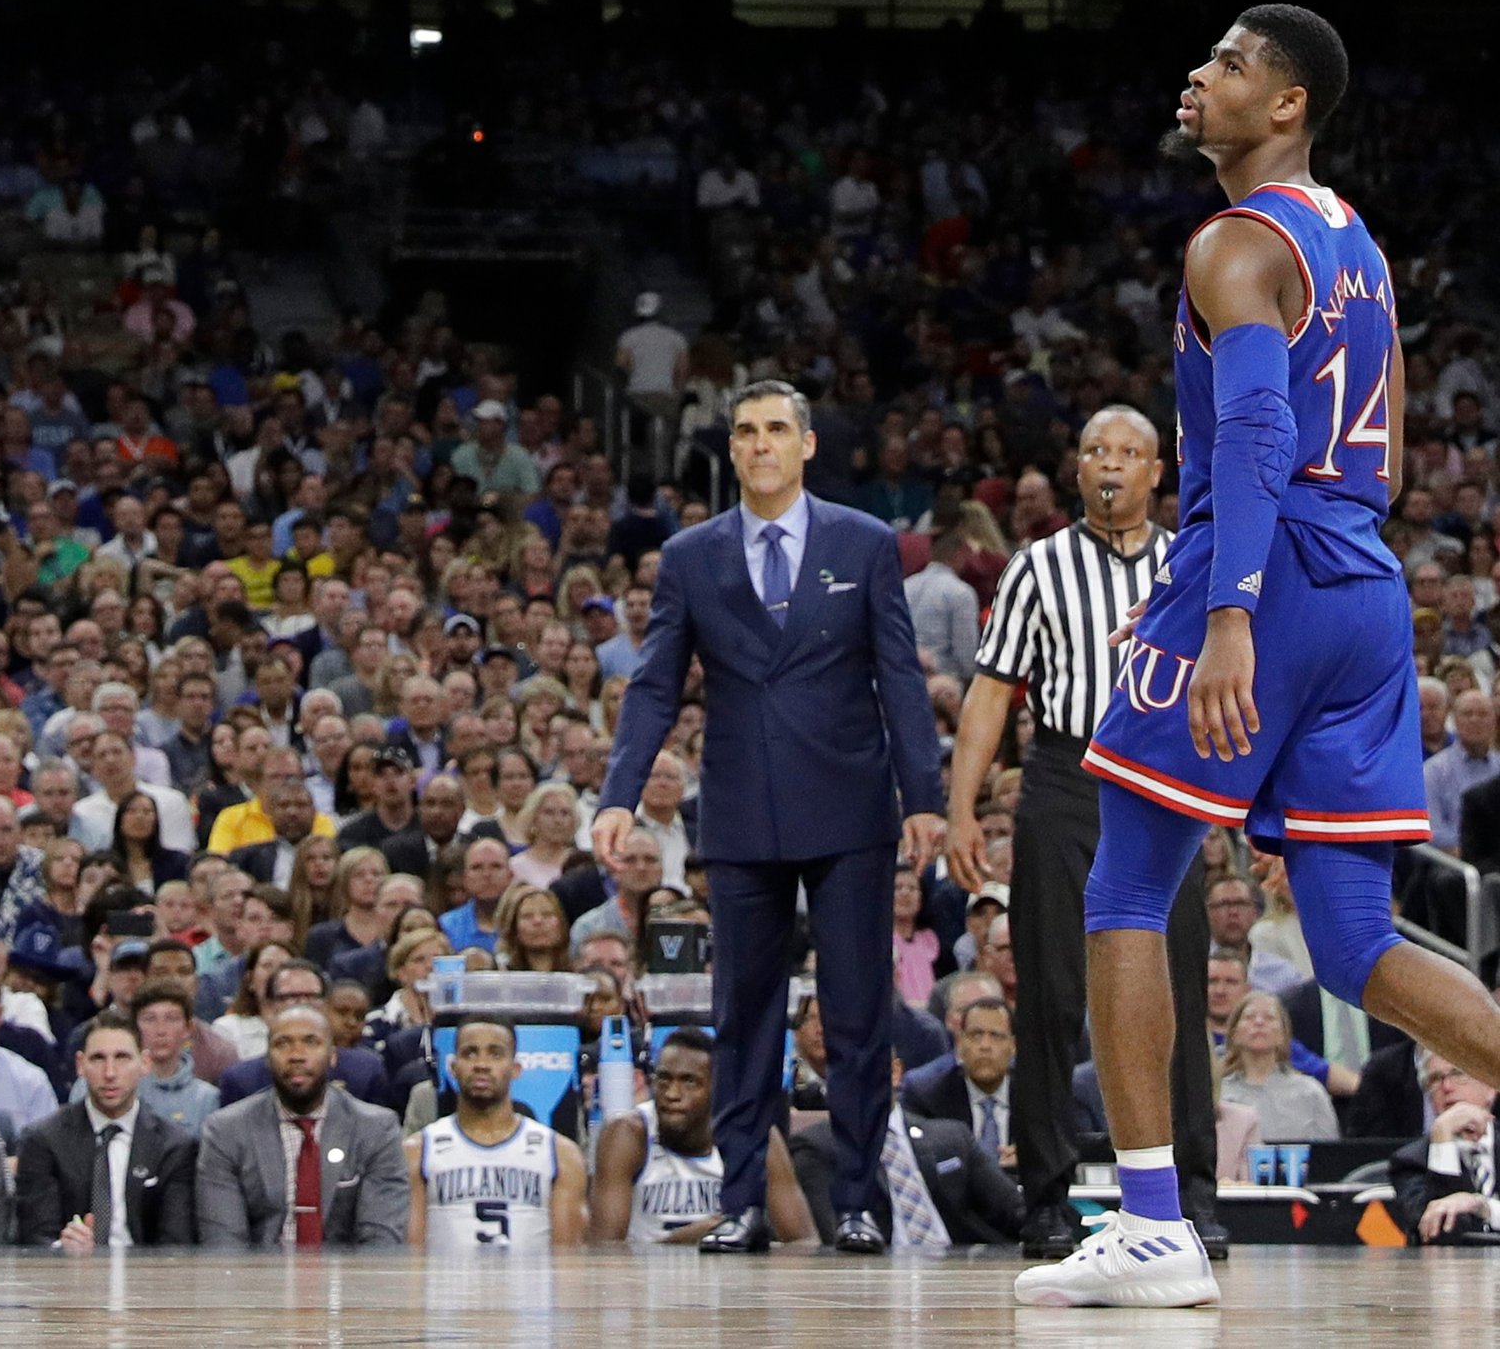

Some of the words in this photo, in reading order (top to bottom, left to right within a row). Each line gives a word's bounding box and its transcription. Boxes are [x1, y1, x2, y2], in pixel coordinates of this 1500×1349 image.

[1305, 343, 1391, 480] 14
[1116, 633, 1195, 714] KU
[434, 1165, 542, 1208] VILLANOVA
[642, 1179, 724, 1215] VILLANO
[475, 1202, 510, 1245] 5
